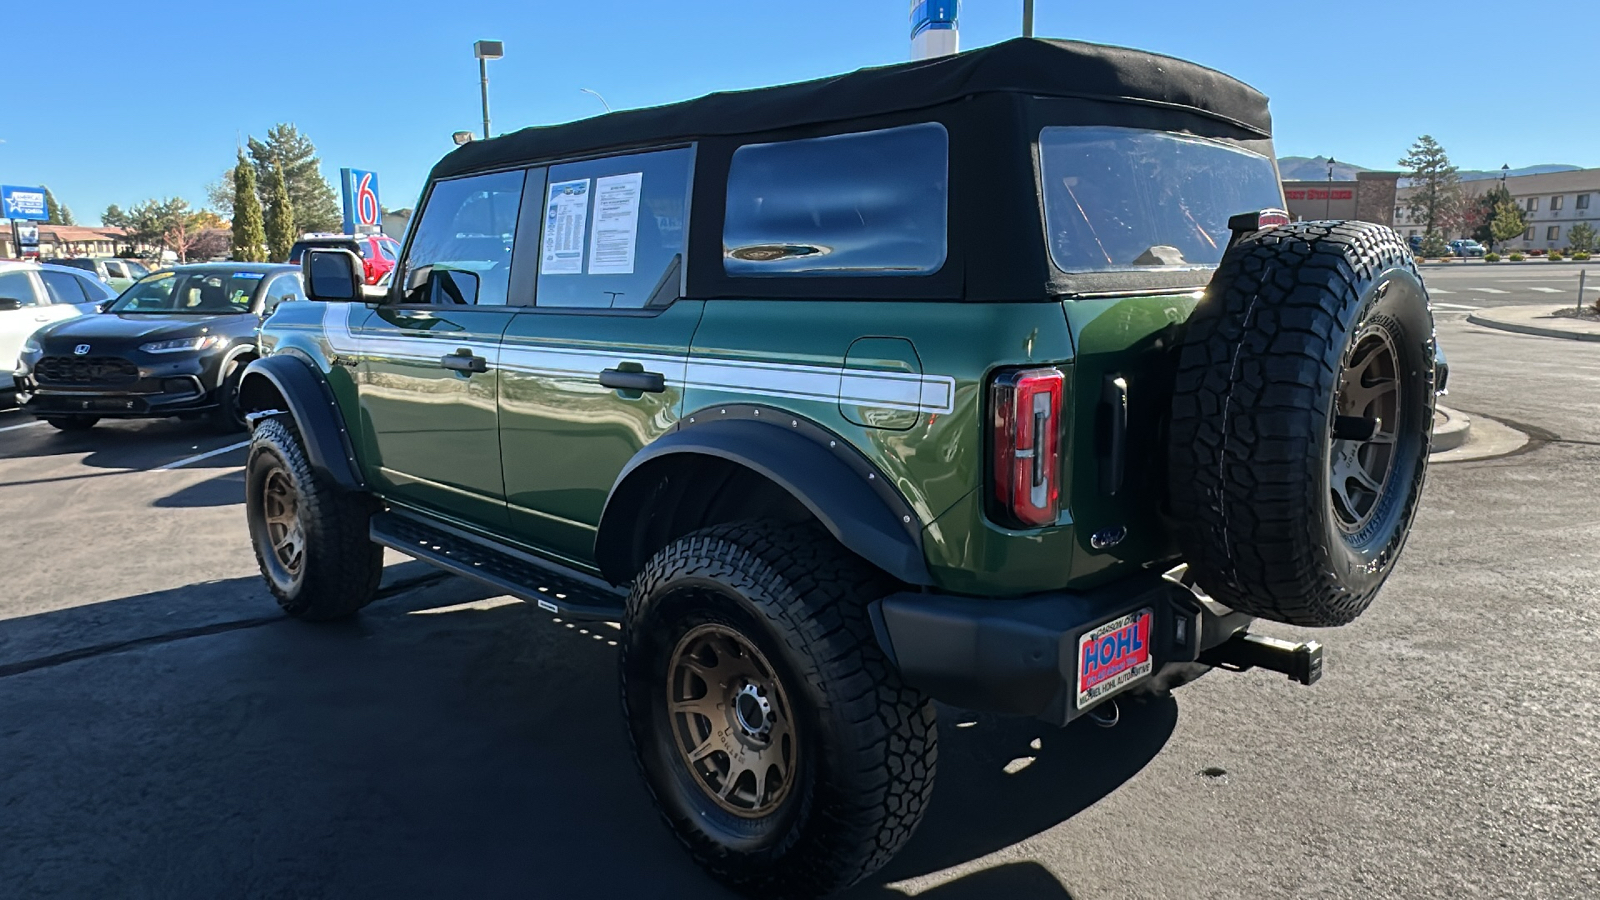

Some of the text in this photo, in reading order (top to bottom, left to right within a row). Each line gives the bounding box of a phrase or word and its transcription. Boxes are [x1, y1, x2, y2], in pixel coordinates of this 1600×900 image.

[358, 172, 378, 225] 6
[1096, 618, 1122, 636] CARSON
[1084, 625, 1142, 676] HOHL
[1102, 679, 1116, 693] HOHL
